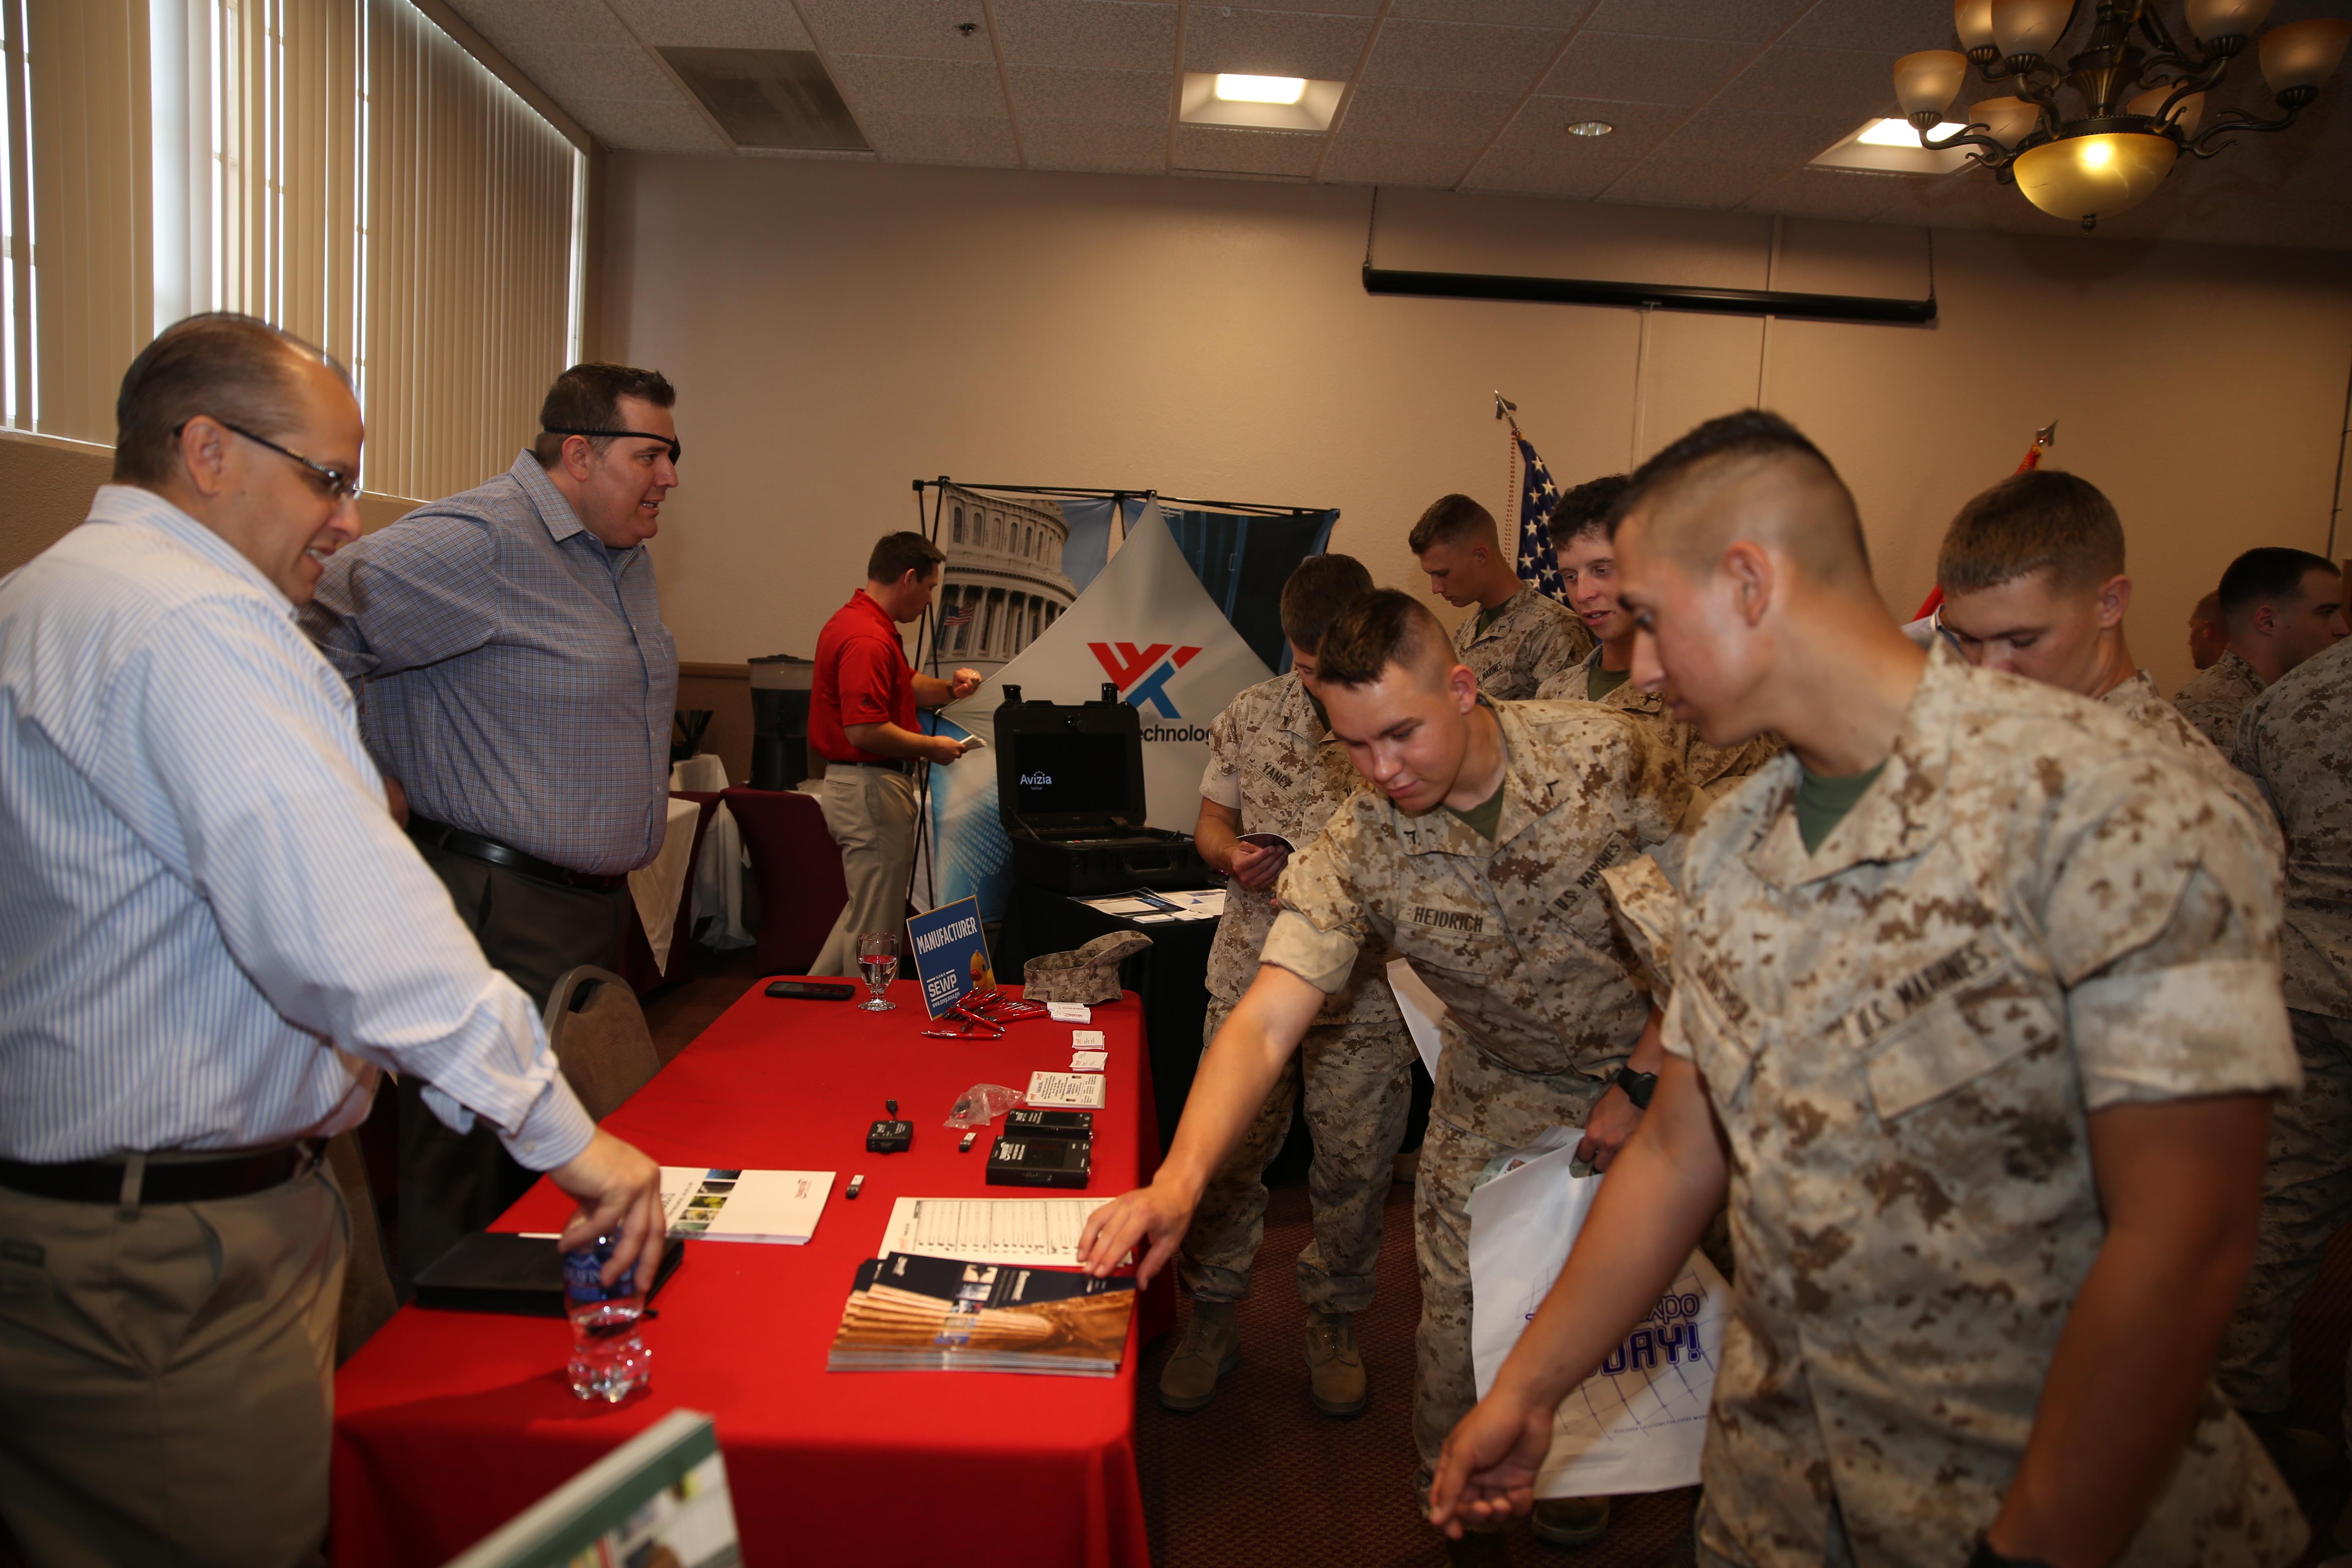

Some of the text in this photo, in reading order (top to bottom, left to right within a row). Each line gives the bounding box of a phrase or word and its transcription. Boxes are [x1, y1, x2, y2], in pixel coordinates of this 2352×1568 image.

[1482, 662, 1502, 680] MARINES
[1140, 724, 1210, 746] chnolo
[1020, 772, 1052, 784] Avizia
[1263, 762, 1293, 791] YANEZ
[1577, 840, 1621, 890] MARINES
[1414, 906, 1483, 933] HEIDRICH
[916, 917, 978, 955] MANUFACTURER
[928, 974, 957, 998] SEWP
[932, 991, 960, 1008] www.sewp.nasa.gov
[1643, 1293, 1700, 1325] xpo
[1598, 1322, 1701, 1376] DAY!
